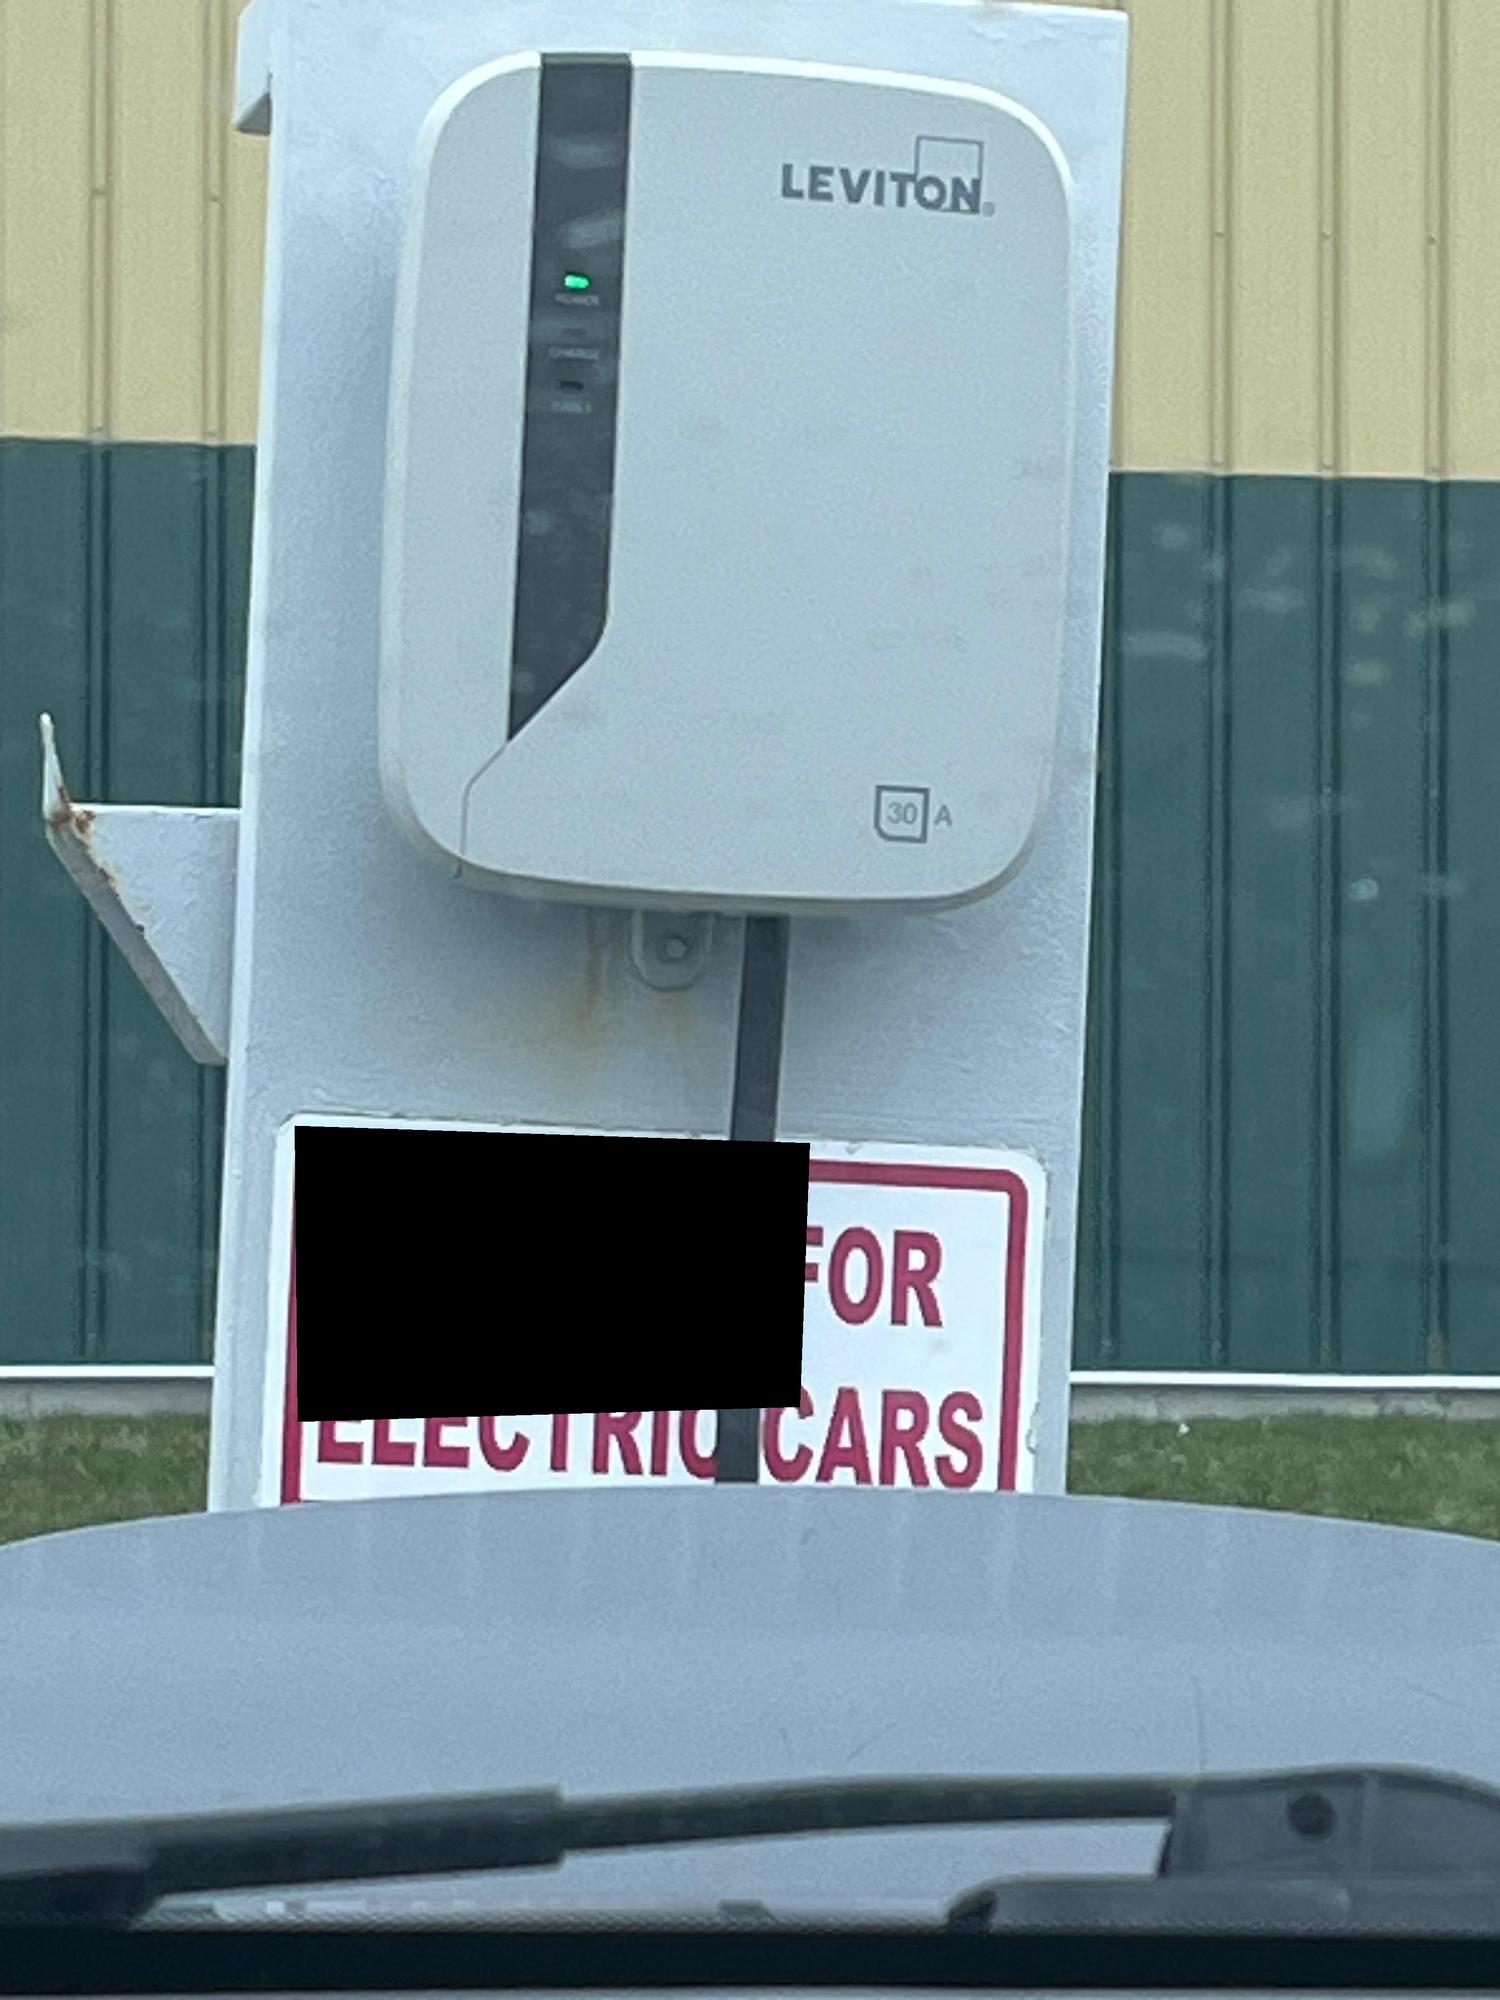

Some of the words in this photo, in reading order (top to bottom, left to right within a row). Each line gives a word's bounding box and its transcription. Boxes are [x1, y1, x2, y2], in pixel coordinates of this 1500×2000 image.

[781, 163, 982, 214] LEVITON
[887, 802, 918, 825] 30
[933, 804, 953, 826] A
[762, 1386, 984, 1489] CARS
